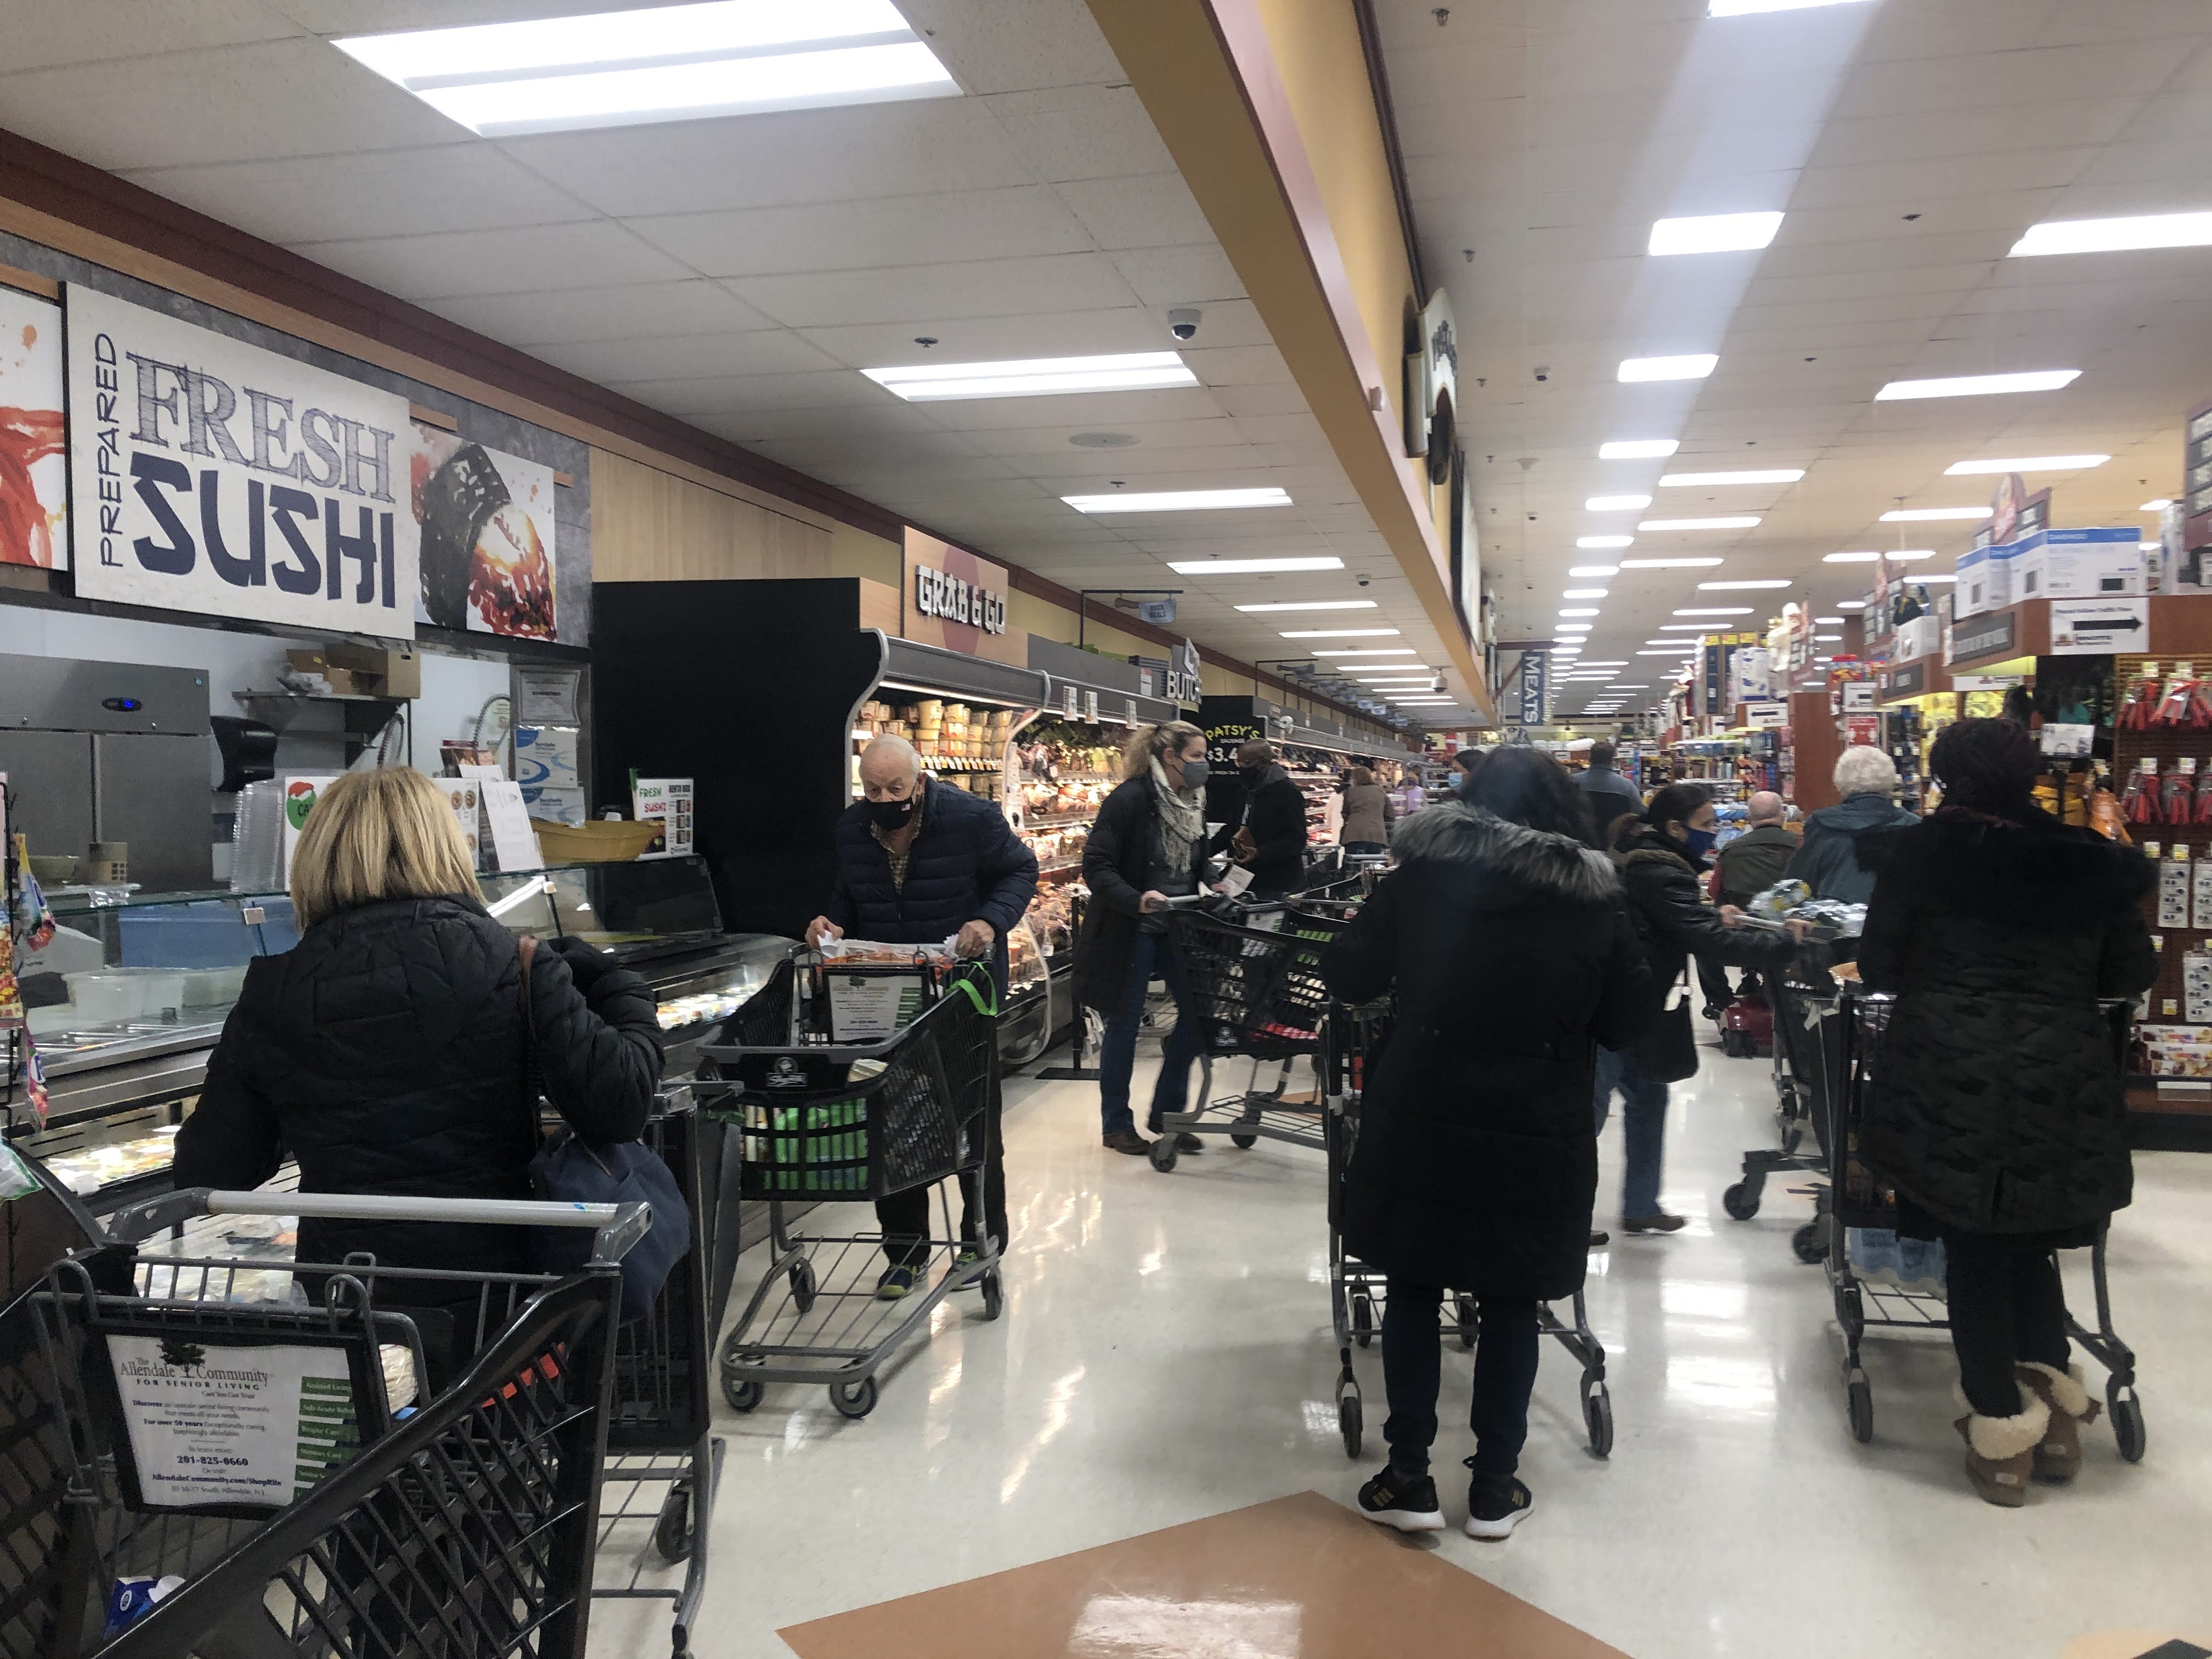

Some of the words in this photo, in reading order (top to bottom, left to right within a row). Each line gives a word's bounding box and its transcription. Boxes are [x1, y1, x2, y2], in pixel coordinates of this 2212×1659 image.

[126, 351, 396, 504] FRESH
[94, 333, 123, 567] PREPARED
[129, 451, 396, 608] SUSHI
[916, 565, 969, 624] GRAB
[972, 585, 983, 628] &
[985, 590, 1007, 635] GO
[1523, 656, 1542, 723] MEATS
[1205, 724, 1260, 741] PATSY'S
[1206, 746, 1238, 763] $3.4
[639, 787, 662, 798] FRESH
[644, 802, 667, 813] SUSHI
[135, 1357, 150, 1365] The
[120, 1361, 175, 1378] Allendale
[196, 1364, 268, 1387] Community
[166, 1380, 210, 1388] SENIOR
[218, 1383, 260, 1391] LIVING
[177, 1455, 249, 1466] 201-825-0660
[153, 1474, 282, 1487] AllendaleCommunity.com/ShopRite
